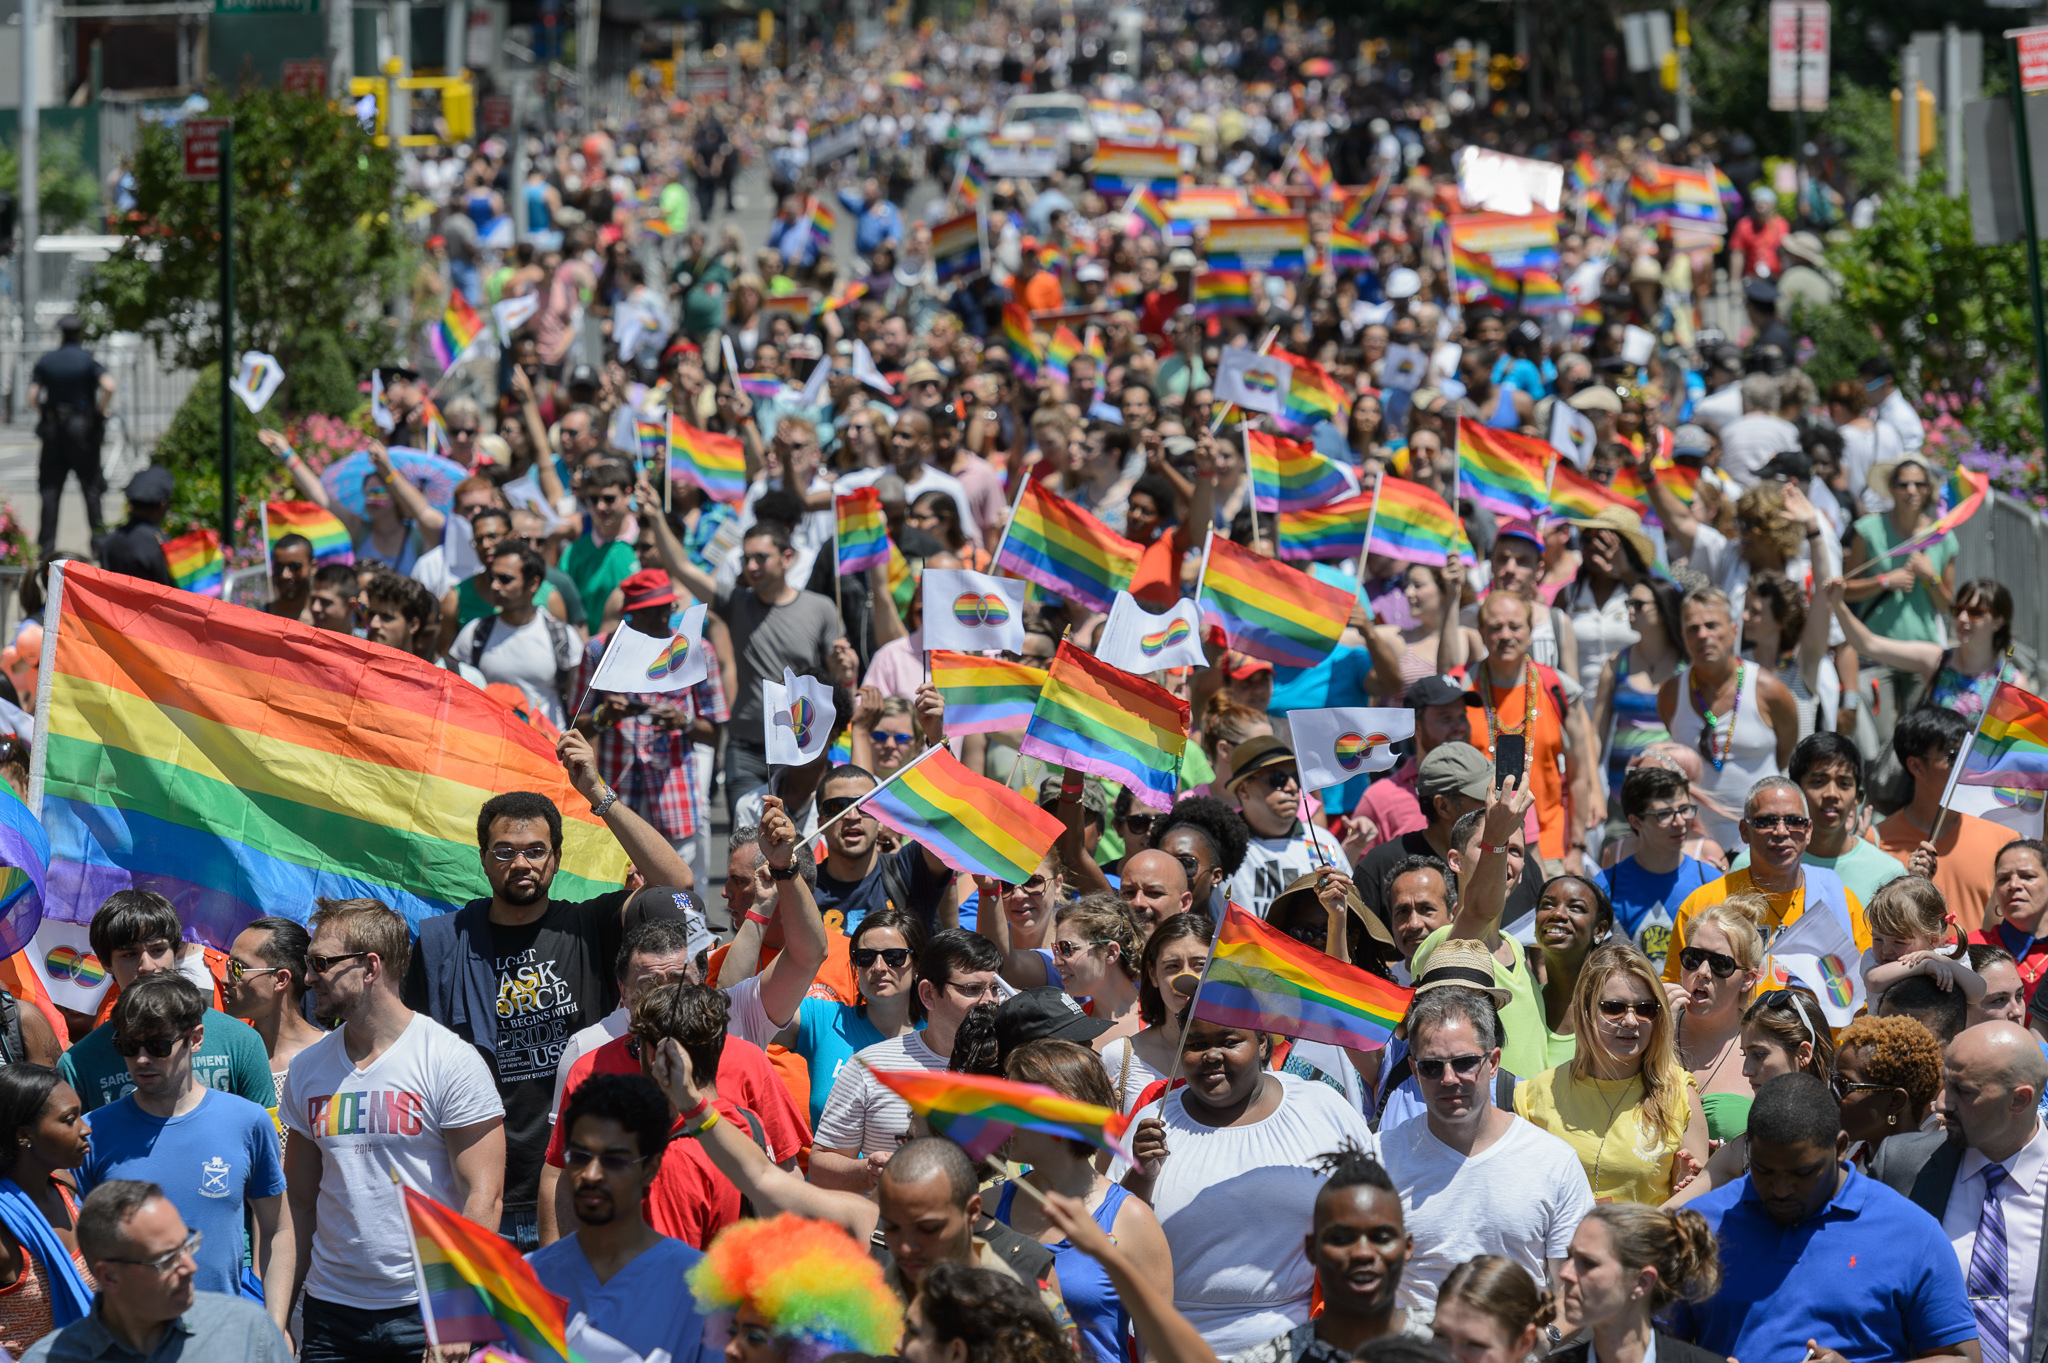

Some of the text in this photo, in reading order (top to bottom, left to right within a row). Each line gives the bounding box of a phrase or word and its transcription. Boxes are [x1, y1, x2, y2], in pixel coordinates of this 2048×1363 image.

[495, 960, 561, 997] ASK
[496, 980, 571, 1018] ORCE
[510, 1010, 550, 1028] BEGINS
[552, 1002, 578, 1018] WITH
[498, 1018, 568, 1050] PRIDE
[501, 1073, 531, 1083] UNIVERSITY
[355, 1144, 372, 1154] 2014
